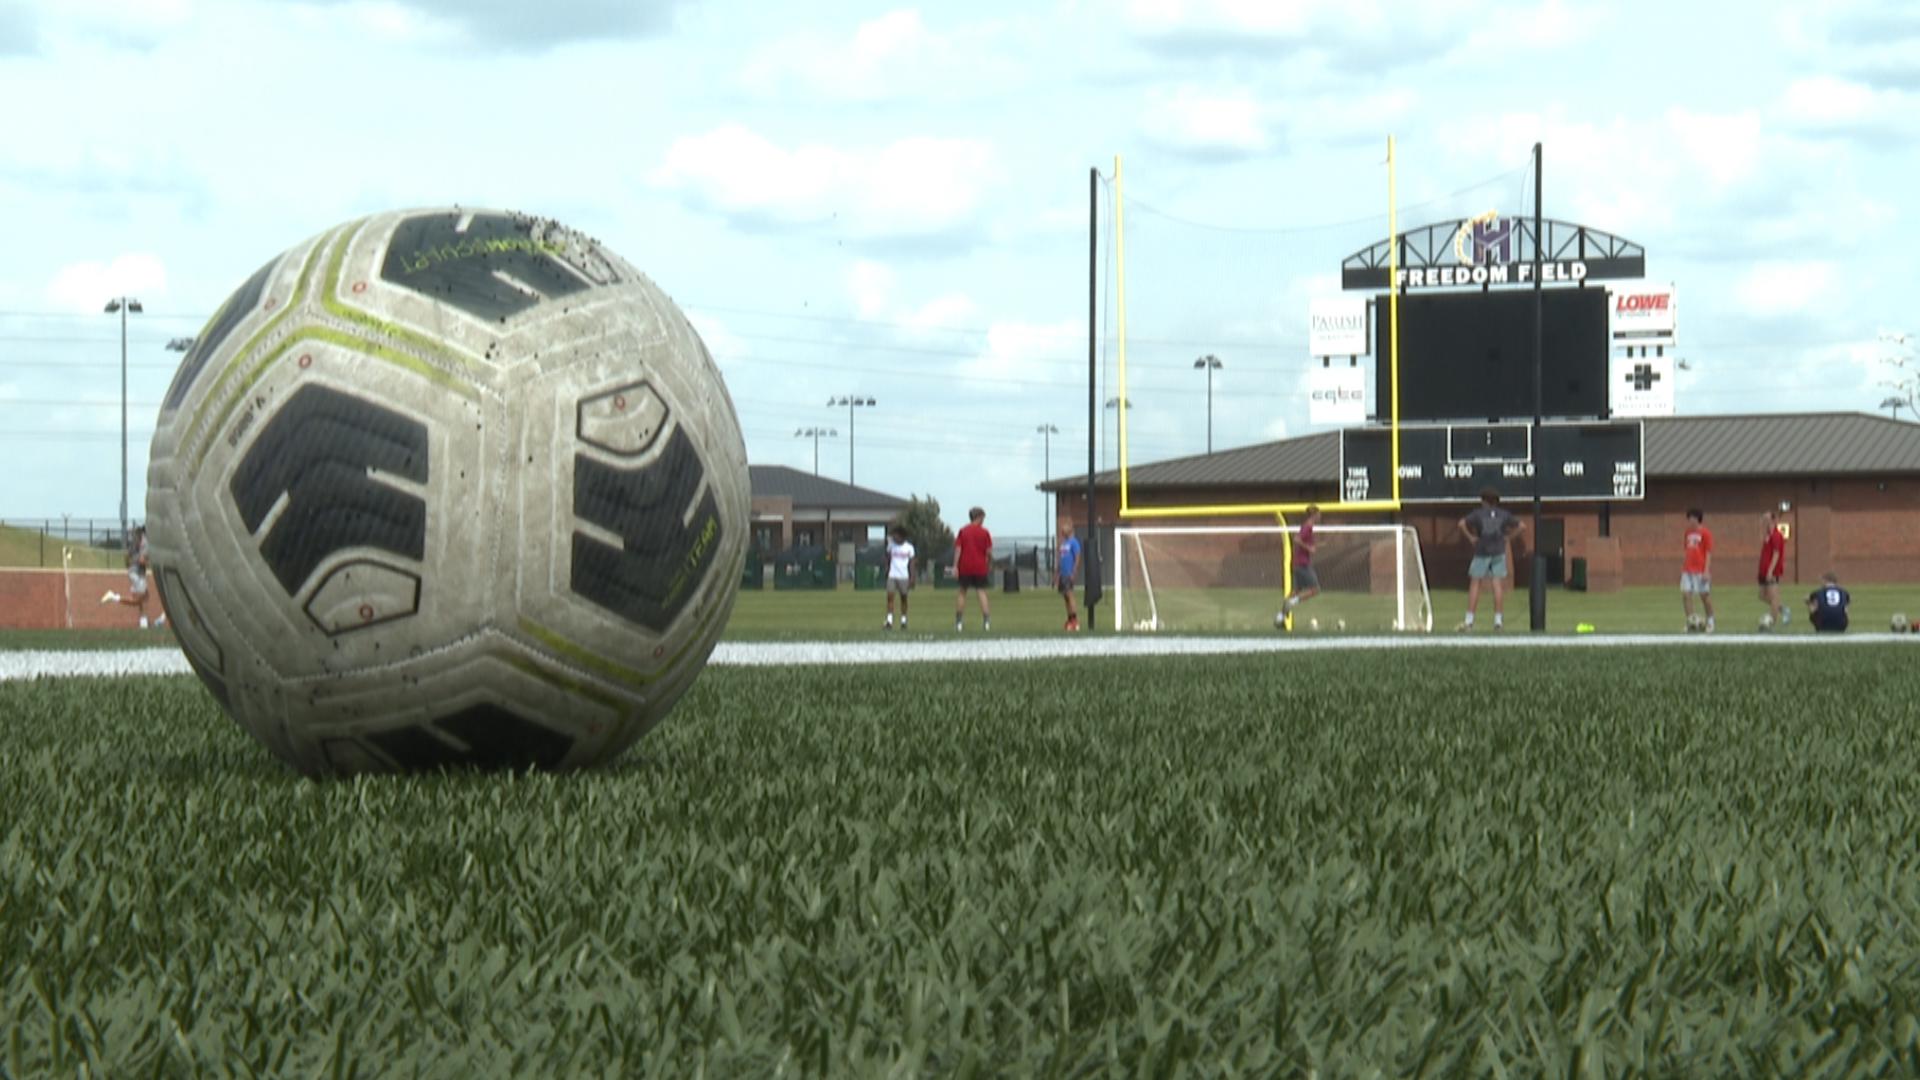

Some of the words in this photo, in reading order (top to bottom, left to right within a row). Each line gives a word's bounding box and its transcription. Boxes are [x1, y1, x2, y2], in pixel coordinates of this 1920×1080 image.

[1396, 264, 1508, 286] FREEDOM
[1347, 466, 1368, 477] TIME
[1399, 464, 1422, 478] OWN
[1443, 464, 1456, 478] TO
[1457, 464, 1473, 477] GO
[1502, 463, 1524, 477] BALL
[1563, 461, 1584, 476] QTR
[1615, 461, 1636, 473] TIME
[1345, 477, 1370, 489] OUTS
[1613, 473, 1638, 485] OUTS
[1345, 489, 1368, 500] LEFT
[1613, 485, 1636, 497] LEFT
